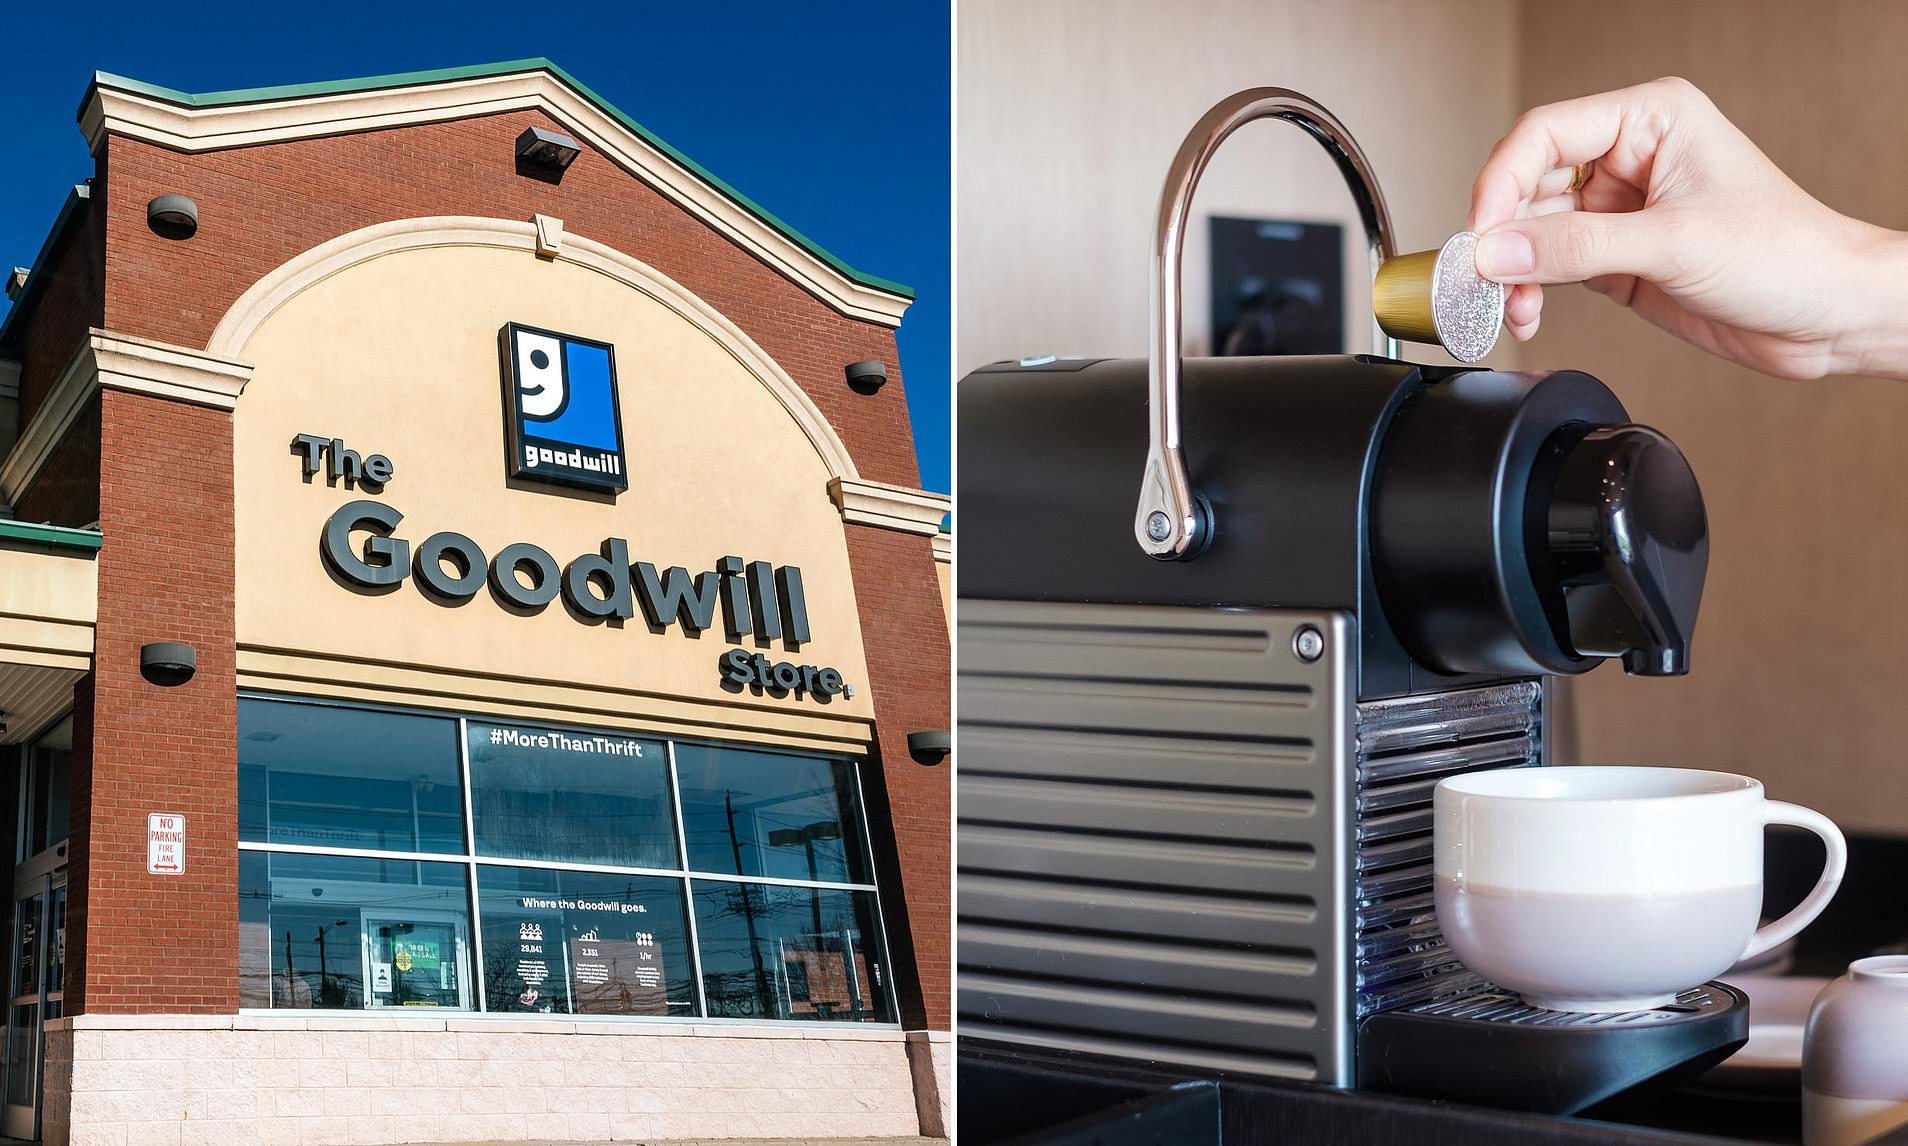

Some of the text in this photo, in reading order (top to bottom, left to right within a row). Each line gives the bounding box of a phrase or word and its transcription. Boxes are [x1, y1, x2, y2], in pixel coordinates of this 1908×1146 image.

[296, 433, 394, 488] The
[525, 444, 620, 475] goodwill
[322, 500, 811, 646] Goodwill
[490, 728, 643, 757] #MoreThanThrift
[160, 818, 173, 829] NO
[151, 831, 182, 843] PARKING
[159, 844, 175, 853] FIRE
[157, 854, 175, 863] LANE
[522, 897, 648, 914] Where the Goodwill goes.
